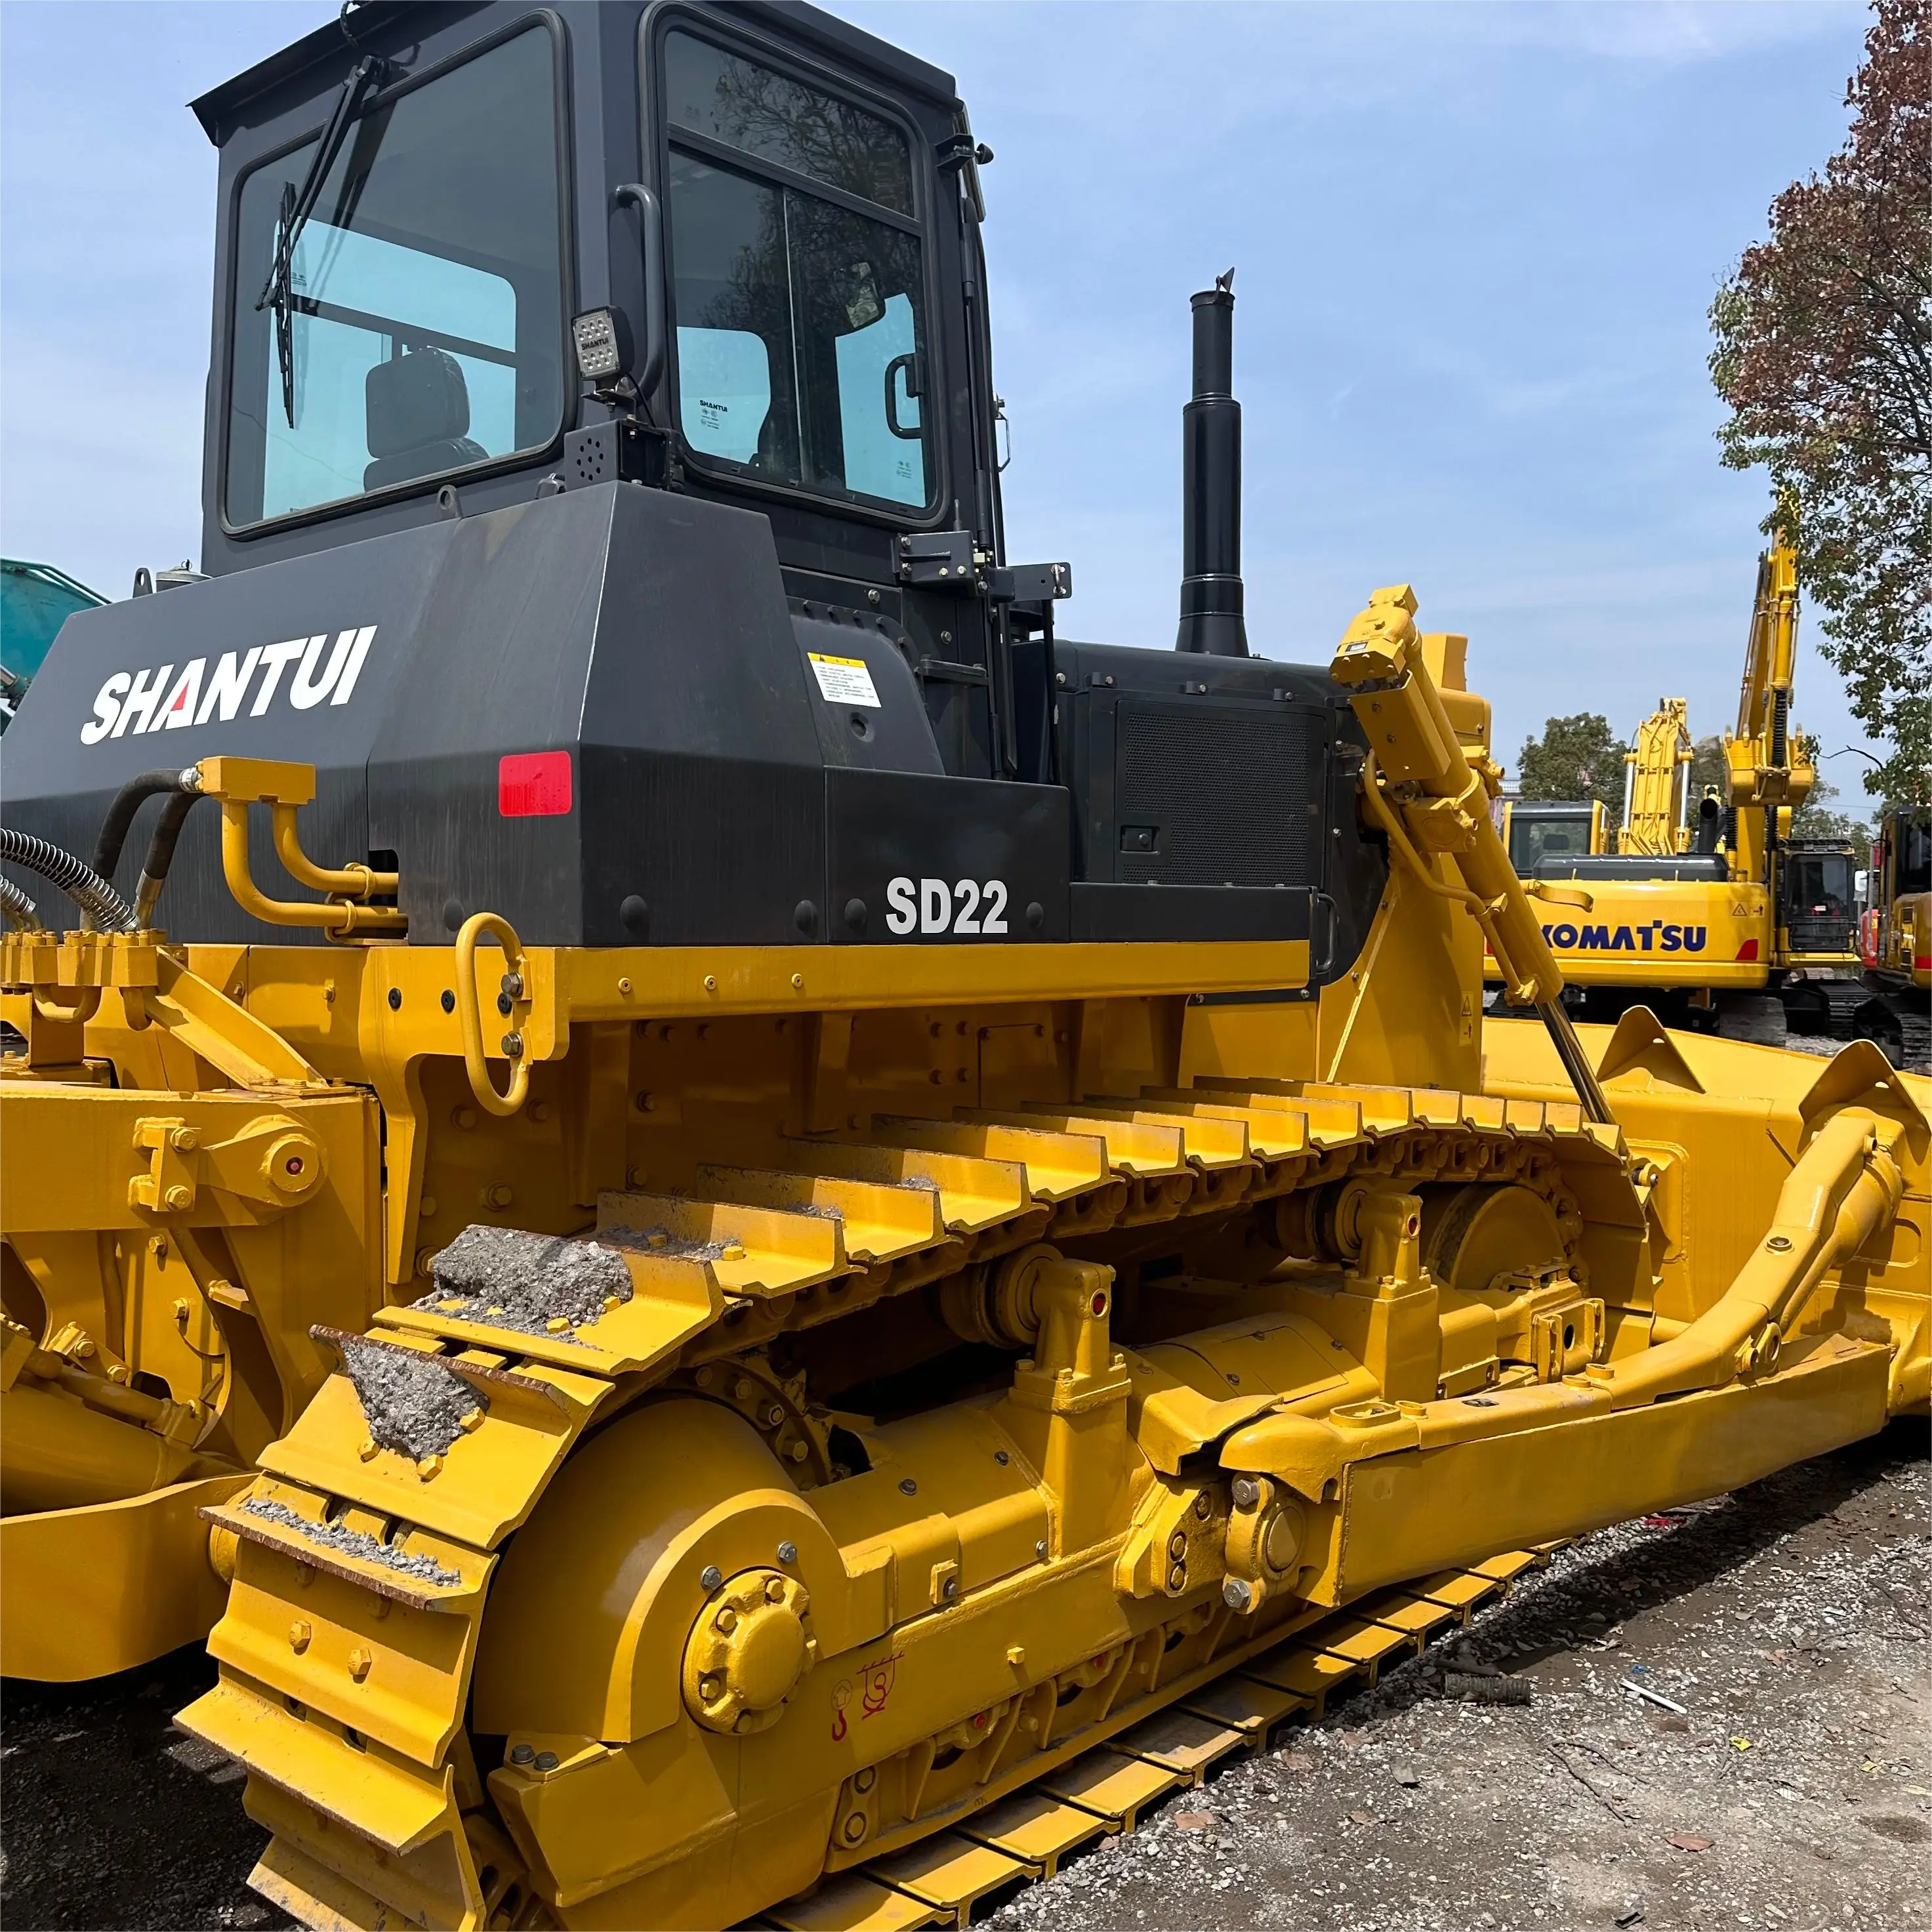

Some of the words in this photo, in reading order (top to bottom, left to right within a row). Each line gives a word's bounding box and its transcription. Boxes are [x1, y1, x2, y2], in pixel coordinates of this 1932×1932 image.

[581, 337, 609, 351] SHANTUI
[699, 400, 728, 413] SHANTUI
[80, 625, 378, 745] SHANTUI
[886, 876, 1008, 935] SD22
